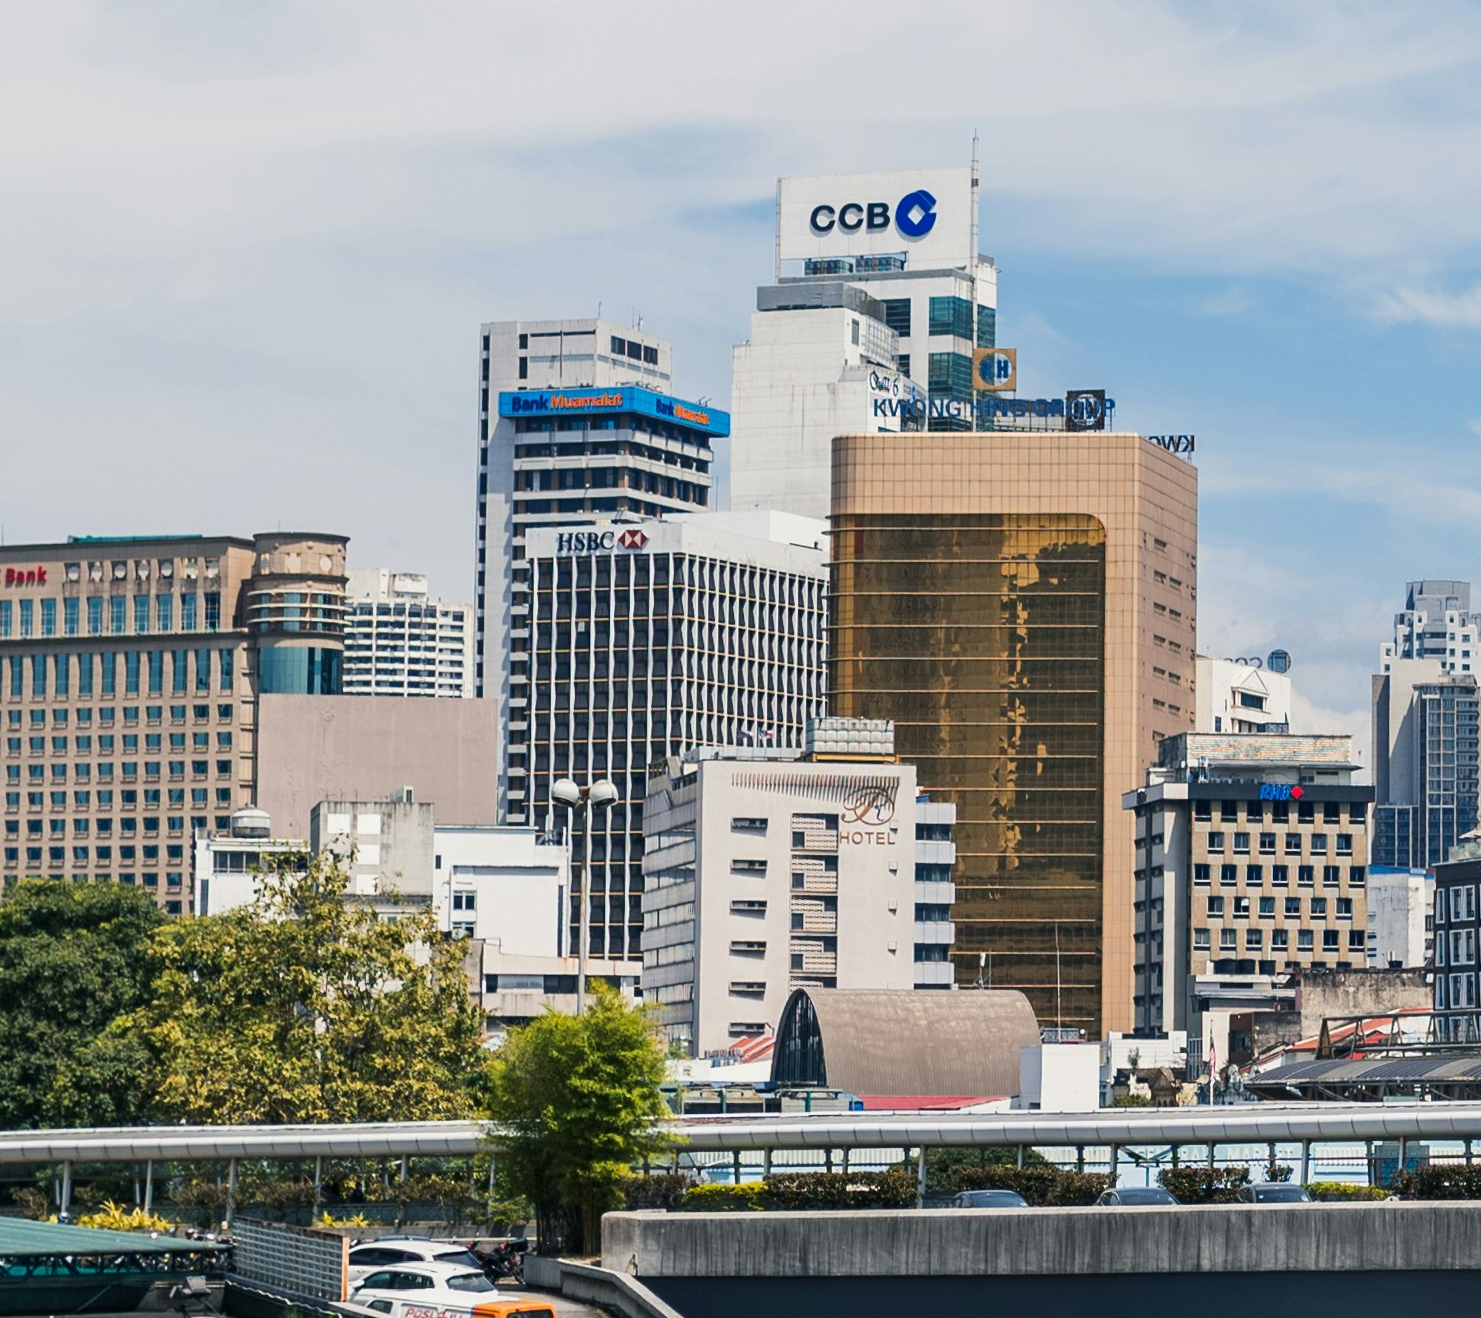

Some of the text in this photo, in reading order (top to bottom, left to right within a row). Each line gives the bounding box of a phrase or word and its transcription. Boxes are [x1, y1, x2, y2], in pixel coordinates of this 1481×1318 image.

[810, 203, 891, 232] CCB
[512, 392, 622, 412] Bank Muamalat
[656, 398, 674, 417] Bank
[874, 398, 961, 417] KWONG
[557, 531, 615, 552] HSBC
[5, 565, 48, 583] Bank
[1260, 784, 1290, 800] RHB
[839, 831, 896, 845] HOTEL
